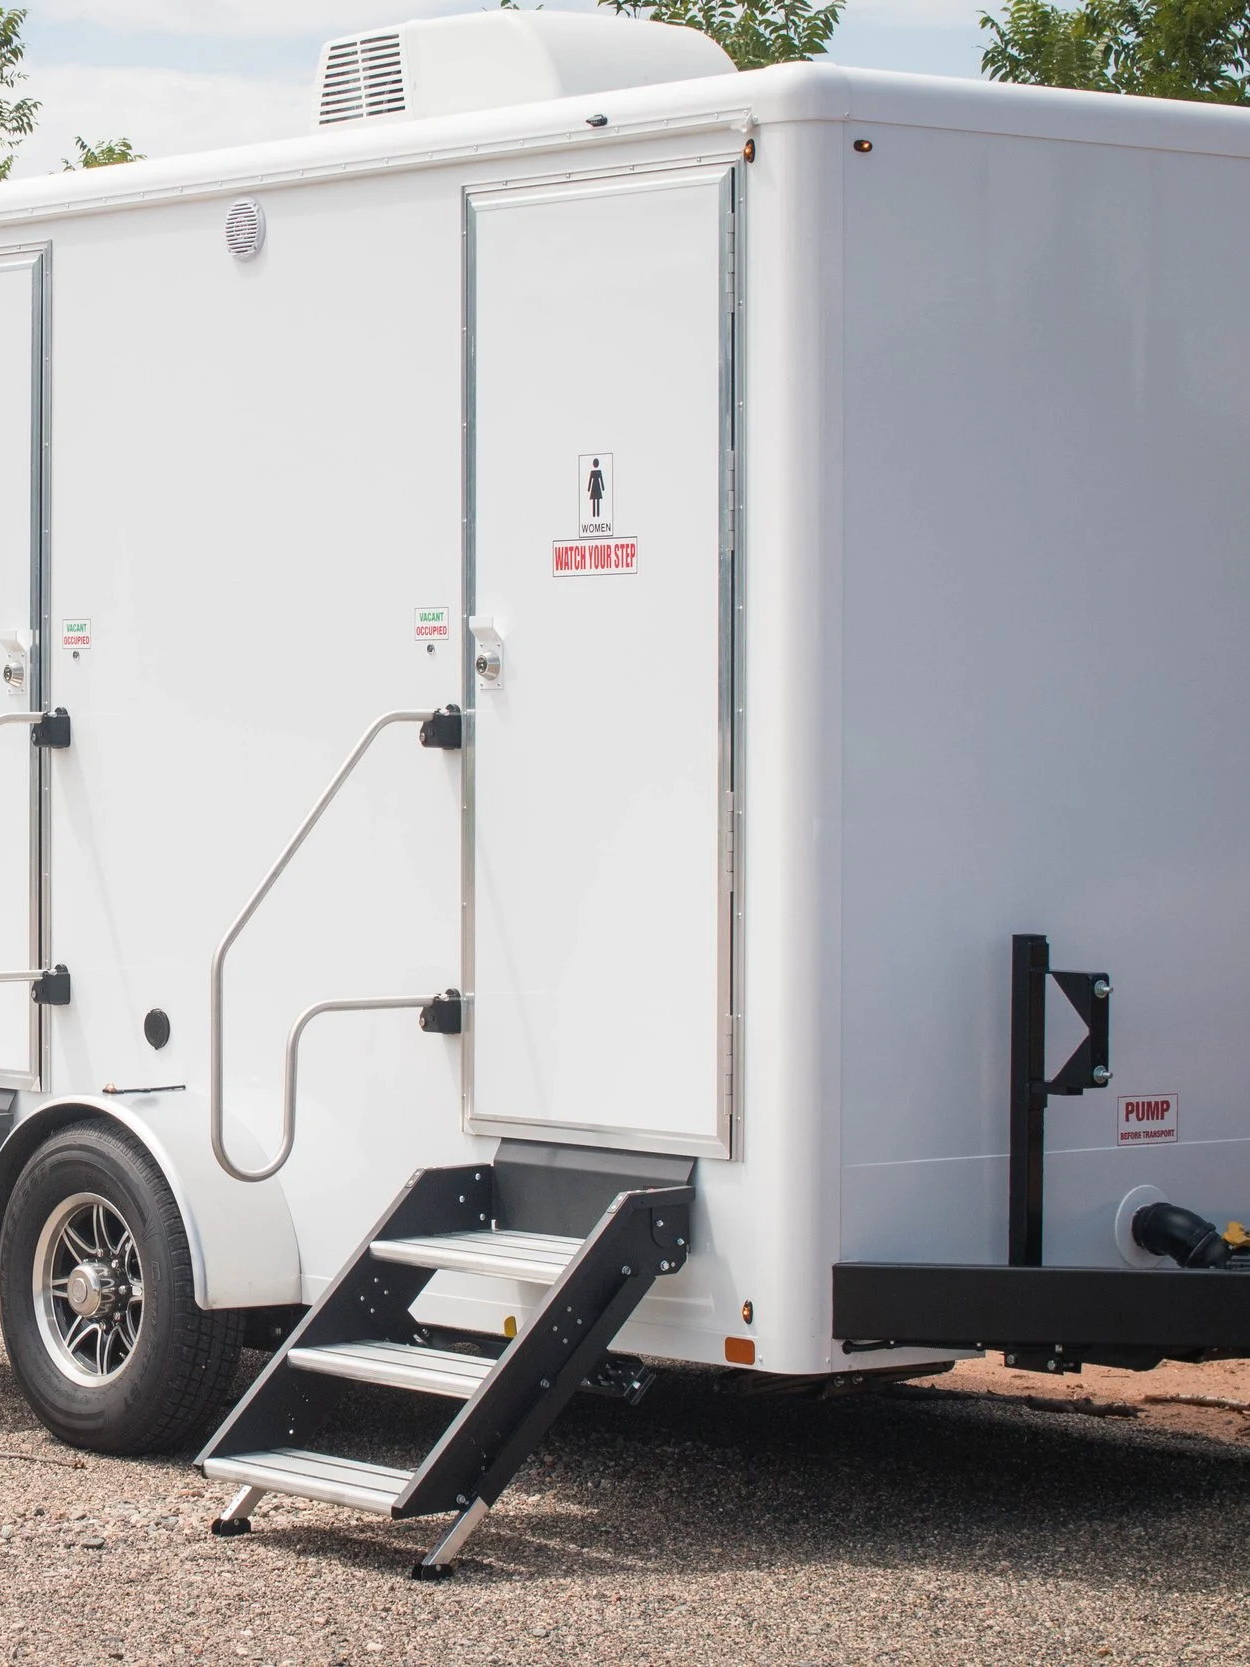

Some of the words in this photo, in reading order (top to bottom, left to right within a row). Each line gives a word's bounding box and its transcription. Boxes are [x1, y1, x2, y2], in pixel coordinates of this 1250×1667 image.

[582, 523, 611, 533] WOMEN
[555, 545, 586, 571] WATCH
[588, 544, 612, 570] YOUR
[614, 543, 636, 568] STEP
[419, 612, 444, 622] VACANT
[66, 623, 87, 632] VACANT
[416, 626, 447, 636] OCCUPIED
[63, 636, 90, 645] OCCUPIED
[1125, 1100, 1171, 1122] PUMP
[1120, 1131, 1142, 1140] BEFORE
[1143, 1129, 1175, 1138] TRANSPORT
